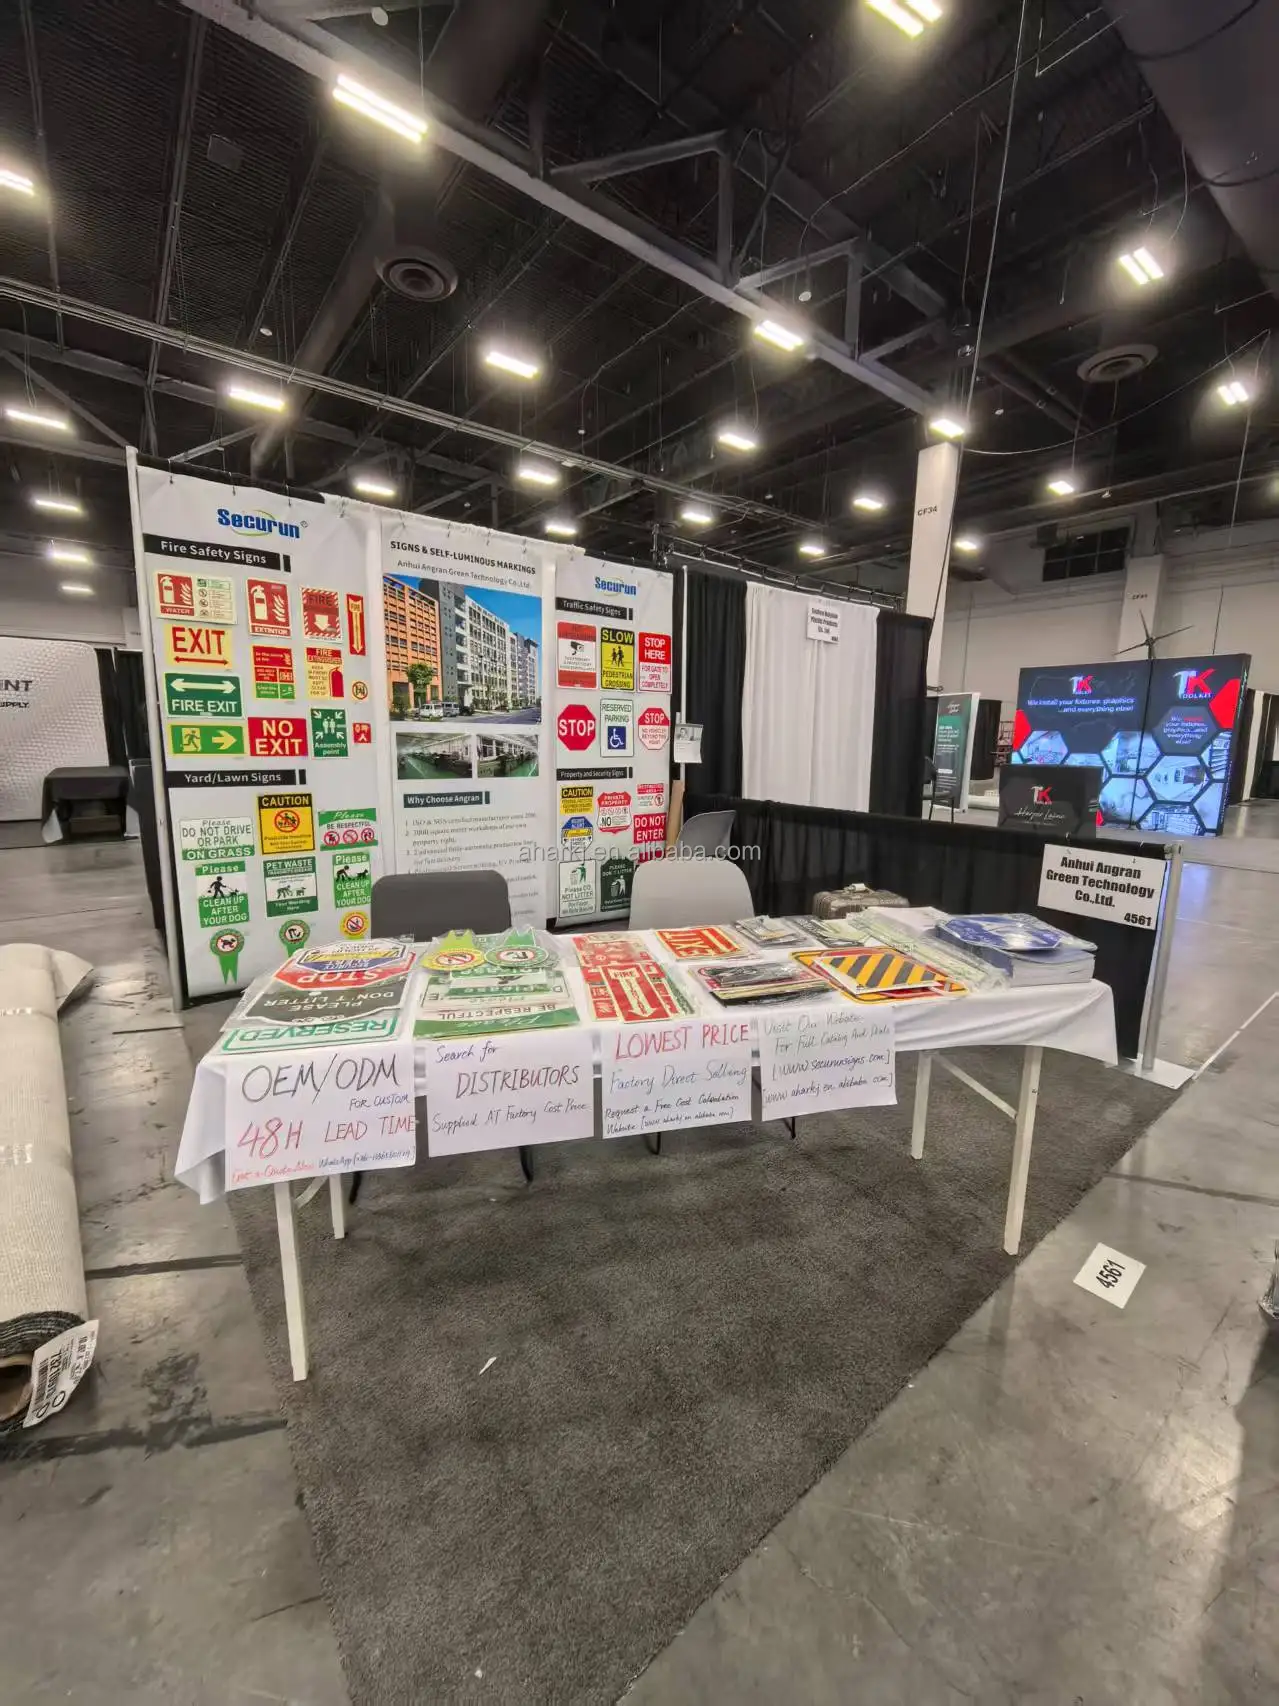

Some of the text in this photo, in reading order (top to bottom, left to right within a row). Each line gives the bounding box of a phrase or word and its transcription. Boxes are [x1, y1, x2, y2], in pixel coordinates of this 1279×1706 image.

[217, 508, 300, 539] Securun
[161, 541, 267, 565] Fire Safety Signs
[390, 540, 536, 575] SIGNS & SELF-LUMINOUS MARKINGS
[595, 576, 637, 596] Securun
[563, 600, 621, 617] Traffic Safety Signs
[172, 626, 225, 655] EXIT
[602, 631, 634, 644] SLOW
[645, 637, 666, 648] STOP
[316, 648, 333, 657] FIRE
[645, 650, 666, 660] HERE
[602, 670, 633, 680] PEDESTRIAN
[0, 679, 33, 692] NT
[171, 699, 237, 713] FIRE EXIT
[601, 703, 632, 712] RESERVED
[604, 714, 630, 723] PARKING
[645, 713, 664, 724] STOP
[262, 720, 294, 737] NO
[558, 719, 595, 736] STOP
[255, 738, 303, 755] EXIT
[184, 771, 282, 785] Yard/Lawn Signs
[563, 788, 593, 797] CAUTION
[261, 796, 310, 807] CAUTION
[407, 794, 480, 806] Why Choose Angran
[601, 816, 612, 827] NO
[635, 816, 666, 828] DO NOT
[182, 825, 252, 837] DO NOT DRIVE
[636, 829, 664, 841] ENTER
[197, 836, 240, 847] OR PARK
[186, 848, 251, 860] ON GRASS
[335, 855, 368, 864] Please
[202, 864, 239, 874] Please
[266, 858, 313, 870] PET WASTE
[1060, 856, 1141, 879] Anhui Angran
[337, 882, 357, 891] CLEAN
[1046, 869, 1155, 899] Green Technology
[343, 889, 365, 897] AFTER
[1075, 889, 1115, 907] Co.,Ltd.
[202, 896, 245, 908] CLEAN UP
[336, 898, 354, 906] YOUR
[211, 905, 239, 914] AFTER
[203, 913, 248, 925] YOUR DOG
[1124, 912, 1152, 927] 4561
[297, 969, 383, 984] STOP
[264, 995, 328, 1006] LITTER
[288, 1000, 362, 1011] PLEASE
[437, 1006, 531, 1020] RESPECTFUL
[239, 1019, 388, 1041] RESERVED
[615, 1023, 749, 1060] LOWEST PRICE
[435, 1041, 498, 1064] Search for
[242, 1053, 399, 1104] OEM/ODM
[456, 1065, 582, 1099] DISTRIBUTORS
[610, 1068, 655, 1095] Factory
[661, 1063, 699, 1089] Direct
[350, 1094, 411, 1110] FOR CUSTOM
[655, 1099, 672, 1113] Free
[506, 1104, 537, 1123] Factory
[324, 1121, 368, 1143] LEAD
[379, 1115, 416, 1137] TIME
[1096, 1259, 1126, 1288] 4561
